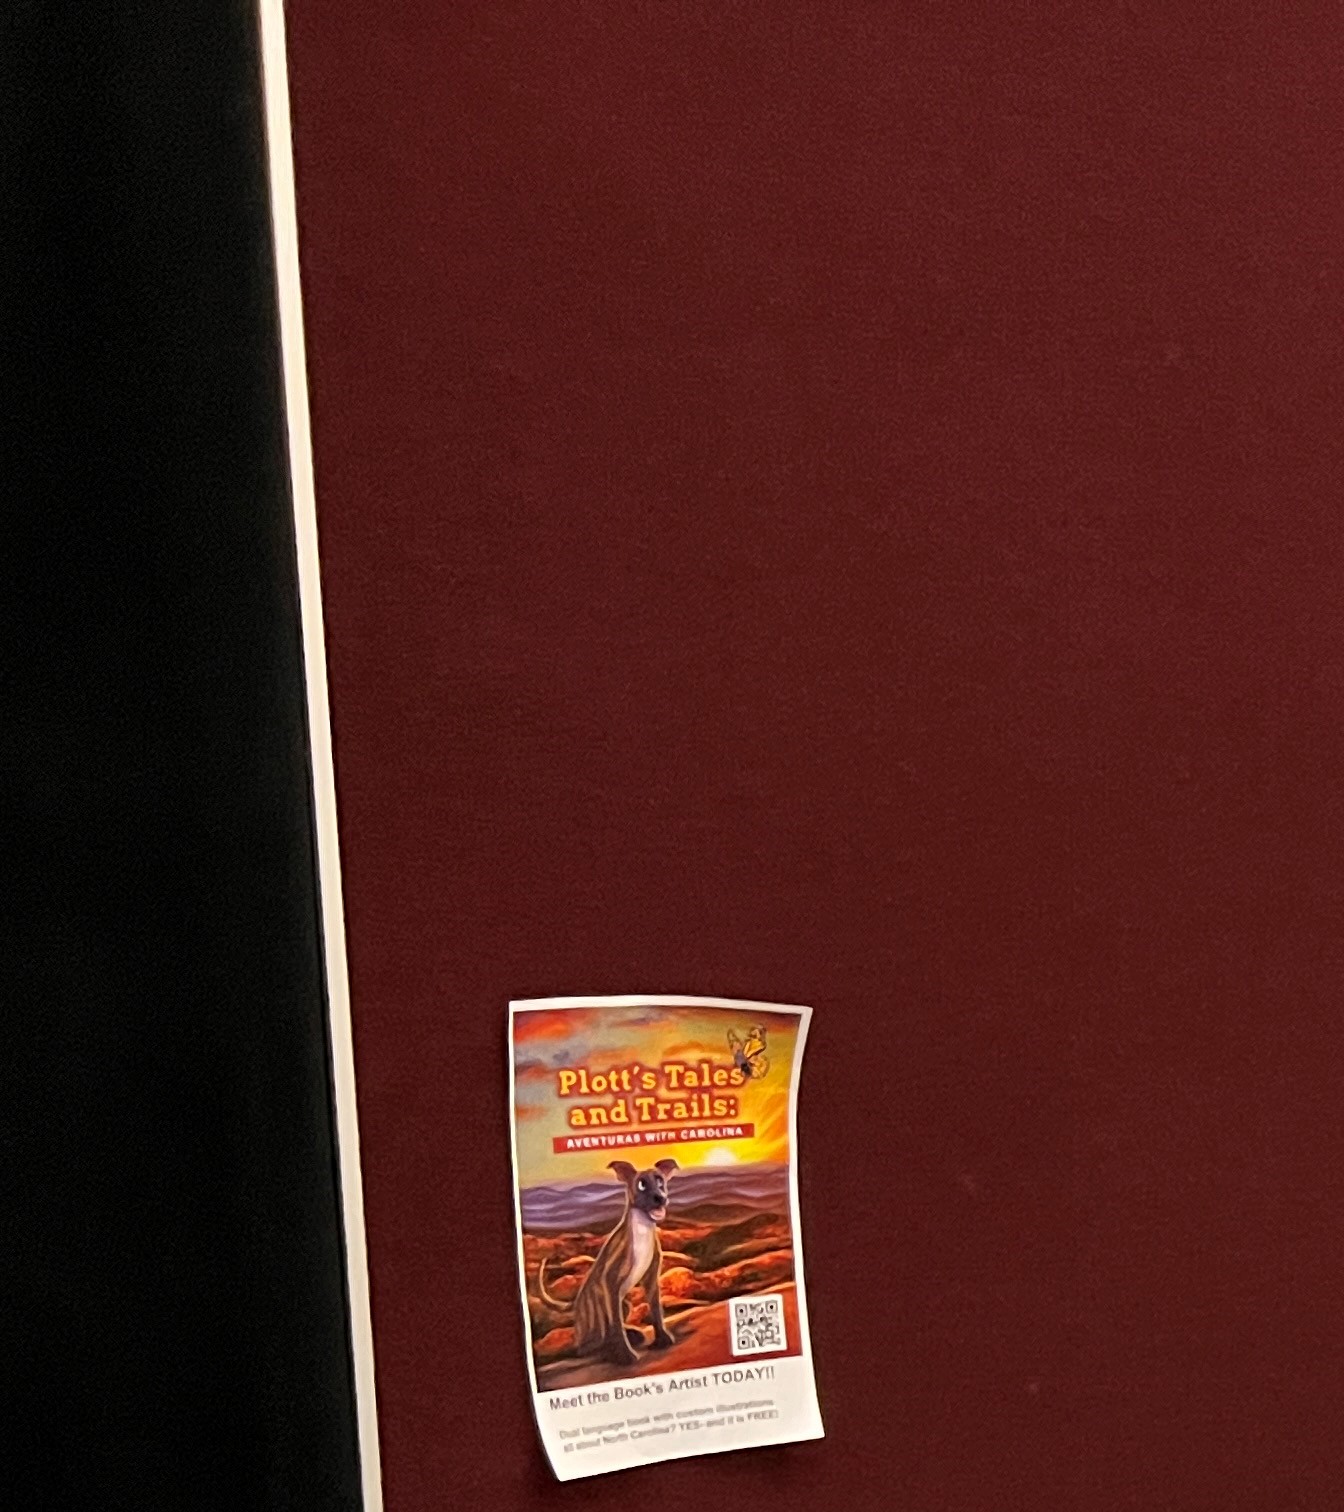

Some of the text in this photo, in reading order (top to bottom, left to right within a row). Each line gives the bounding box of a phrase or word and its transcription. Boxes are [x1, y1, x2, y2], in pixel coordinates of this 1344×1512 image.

[559, 1061, 745, 1095] Plott's Tales
[570, 1094, 738, 1126] and Trails:
[566, 1126, 744, 1150] AVENTURAS WITH CAROLINA
[549, 1366, 775, 1411] Meet the Book's Artist TODAY!!
